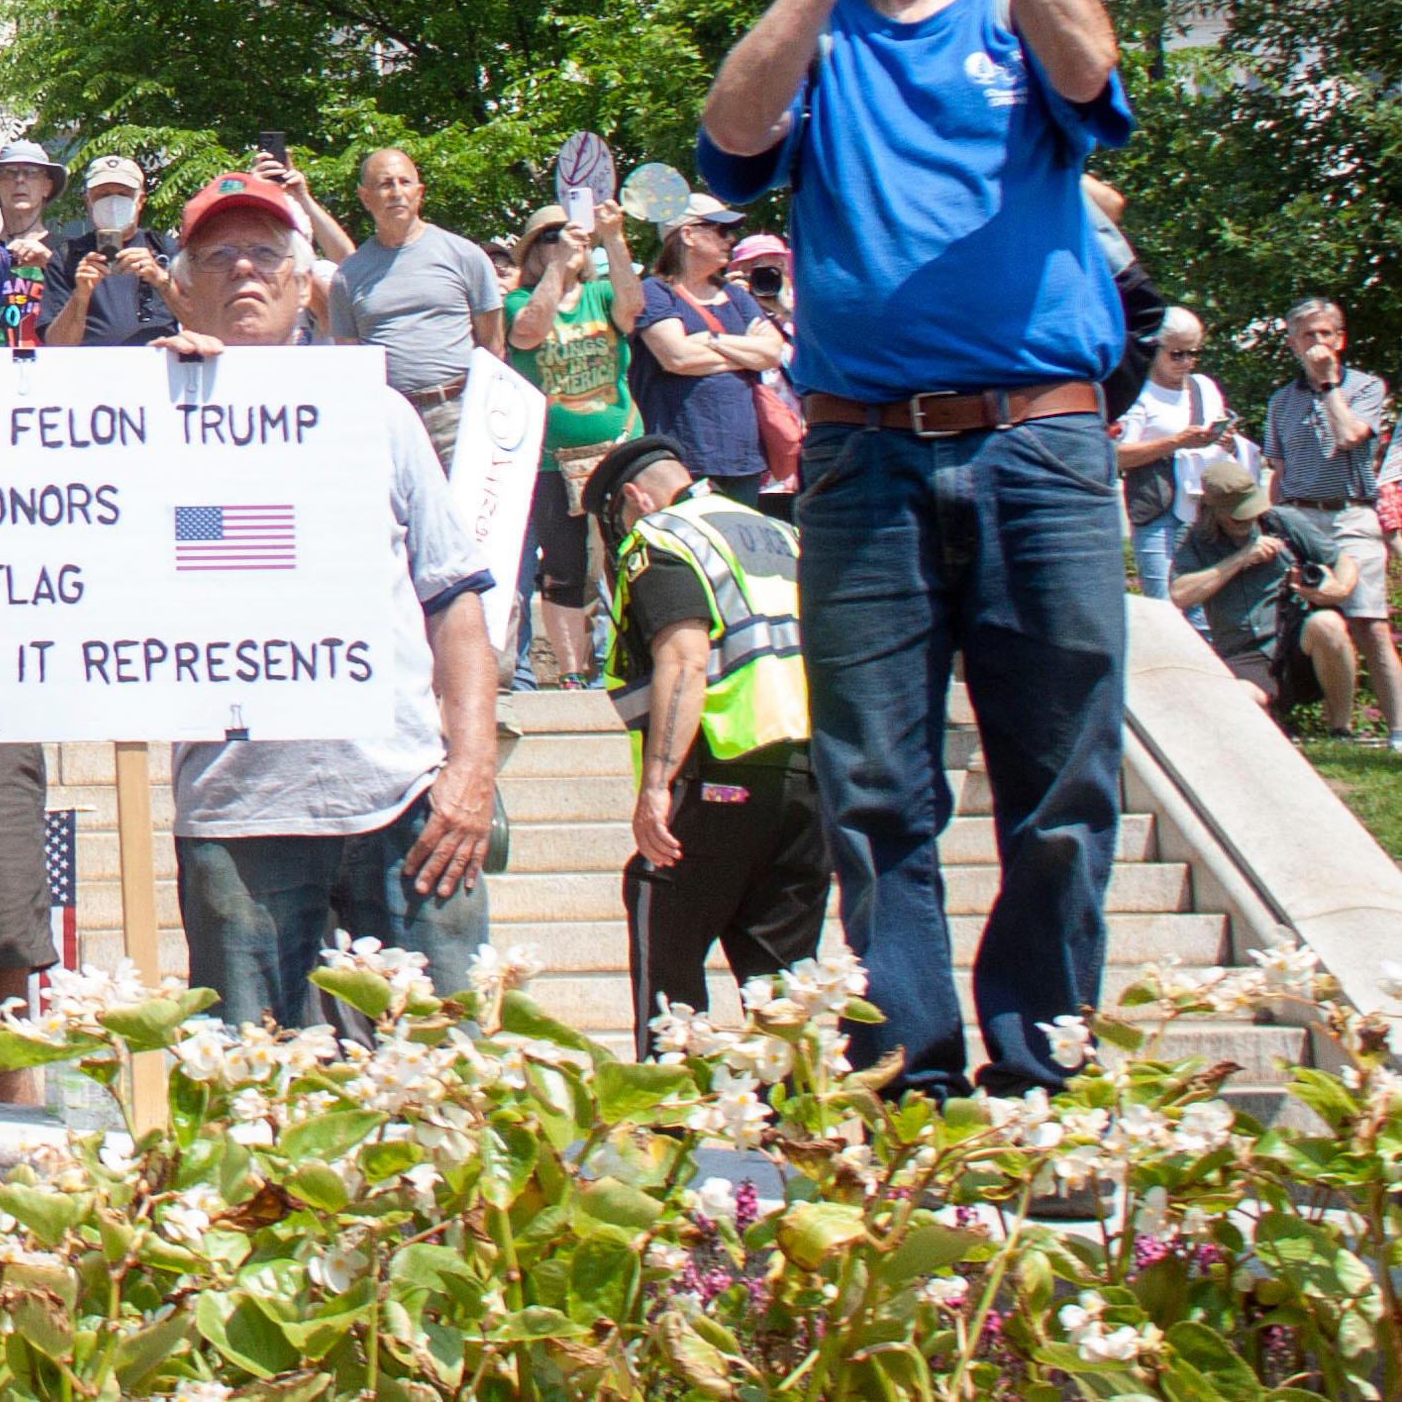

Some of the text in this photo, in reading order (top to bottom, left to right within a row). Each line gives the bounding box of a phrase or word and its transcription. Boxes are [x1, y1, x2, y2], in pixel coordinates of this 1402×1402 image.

[10, 405, 147, 448] FELON
[177, 403, 320, 445] TRUMP
[18, 640, 55, 683] IT
[82, 638, 374, 685] REPRESENTS
